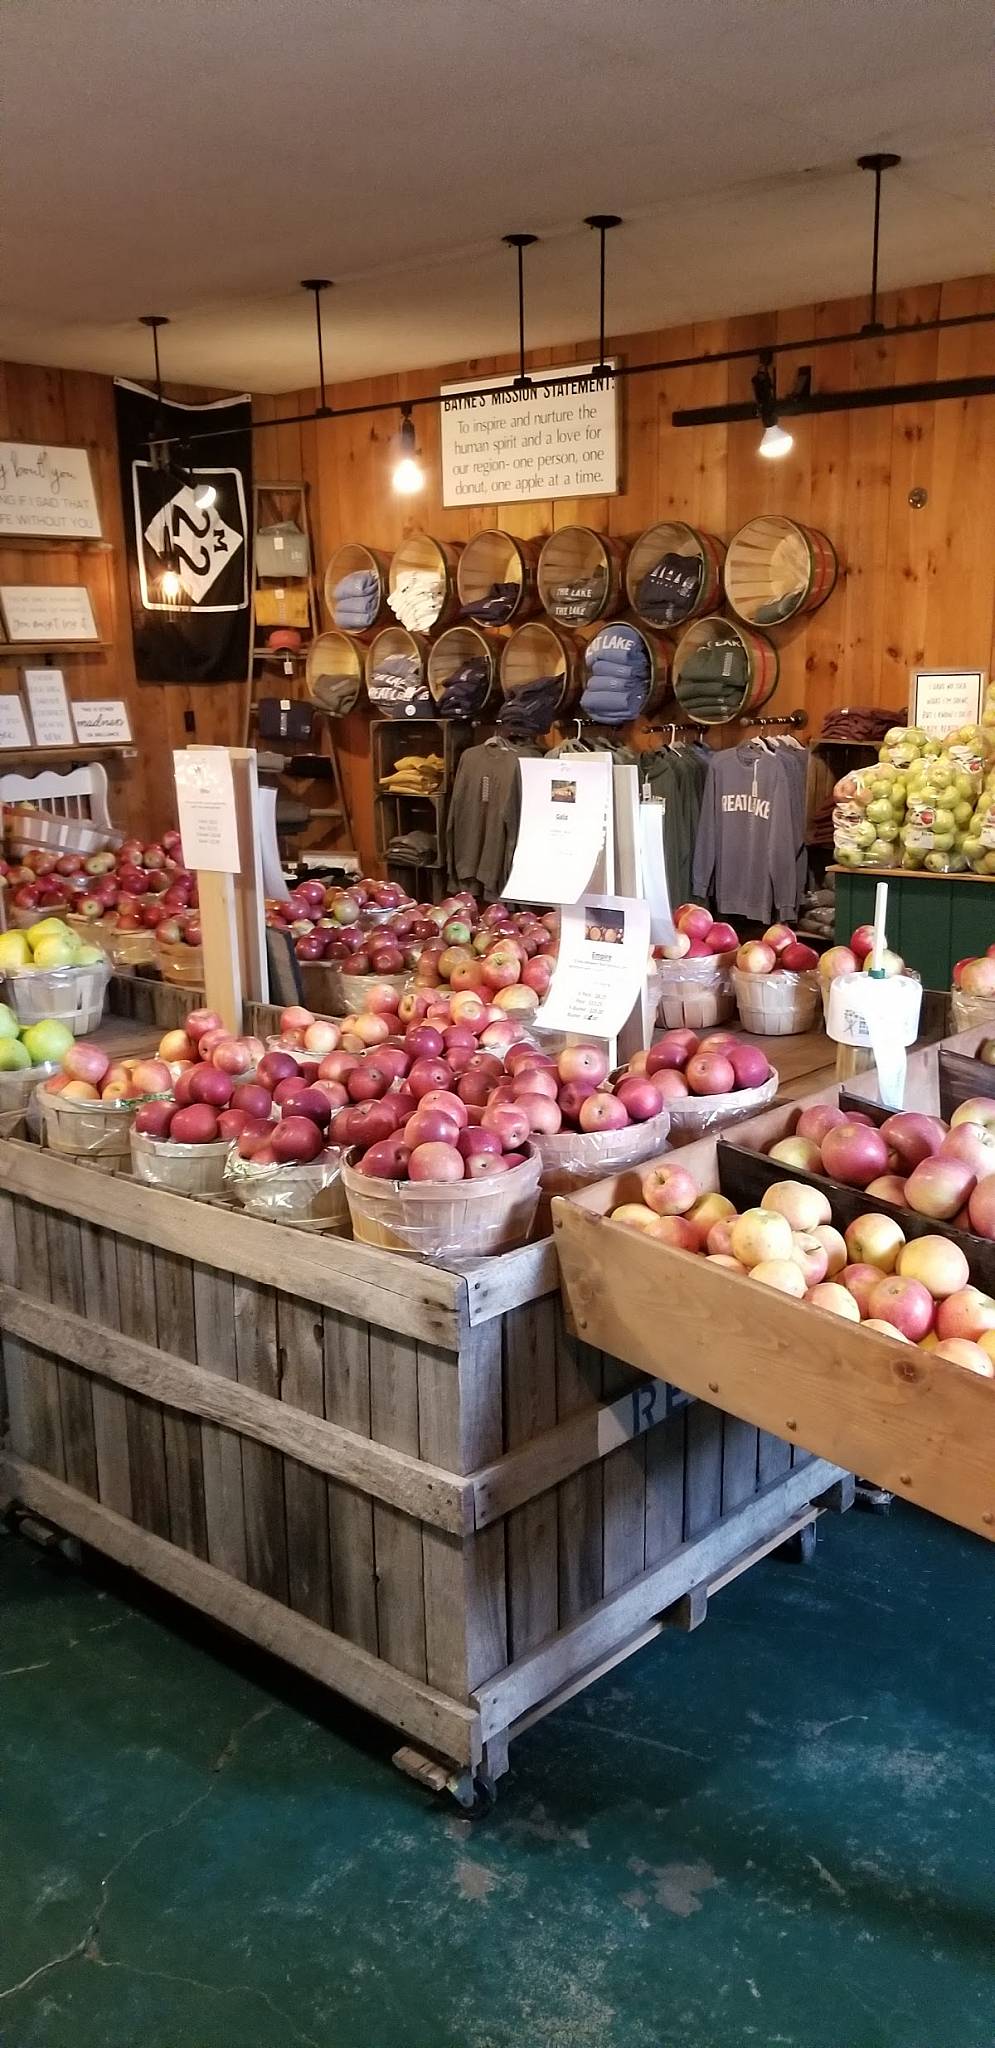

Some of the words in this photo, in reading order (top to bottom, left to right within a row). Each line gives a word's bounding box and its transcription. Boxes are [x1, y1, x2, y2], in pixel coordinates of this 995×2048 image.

[444, 396, 486, 411] BAYNES
[492, 387, 537, 405] MISSION
[543, 377, 615, 398] STATEMENT:
[457, 420, 470, 434] To
[473, 416, 506, 435] inspire
[510, 411, 530, 428] and
[534, 407, 574, 426] nurture
[578, 403, 597, 419] the
[454, 439, 490, 455] human
[493, 435, 517, 455] spirit
[521, 430, 542, 447] and
[545, 433, 553, 445] a
[556, 428, 582, 443] love
[585, 424, 602, 440] for
[452, 463, 470, 476] our
[472, 458, 511, 476] region-
[512, 457, 533, 469] one
[537, 452, 579, 471] person,
[582, 449, 605, 462] one
[455, 481, 487, 496] donut,
[490, 480, 512, 492] one
[515, 474, 545, 494] apple
[548, 474, 559, 487] at
[563, 474, 571, 486] a
[575, 470, 604, 485] time.
[15, 515, 66, 528] WITHOUT
[72, 517, 94, 529] YOU
[570, 588, 593, 598] LAKE
[568, 606, 587, 616] LAKE
[602, 634, 635, 651] LAKE
